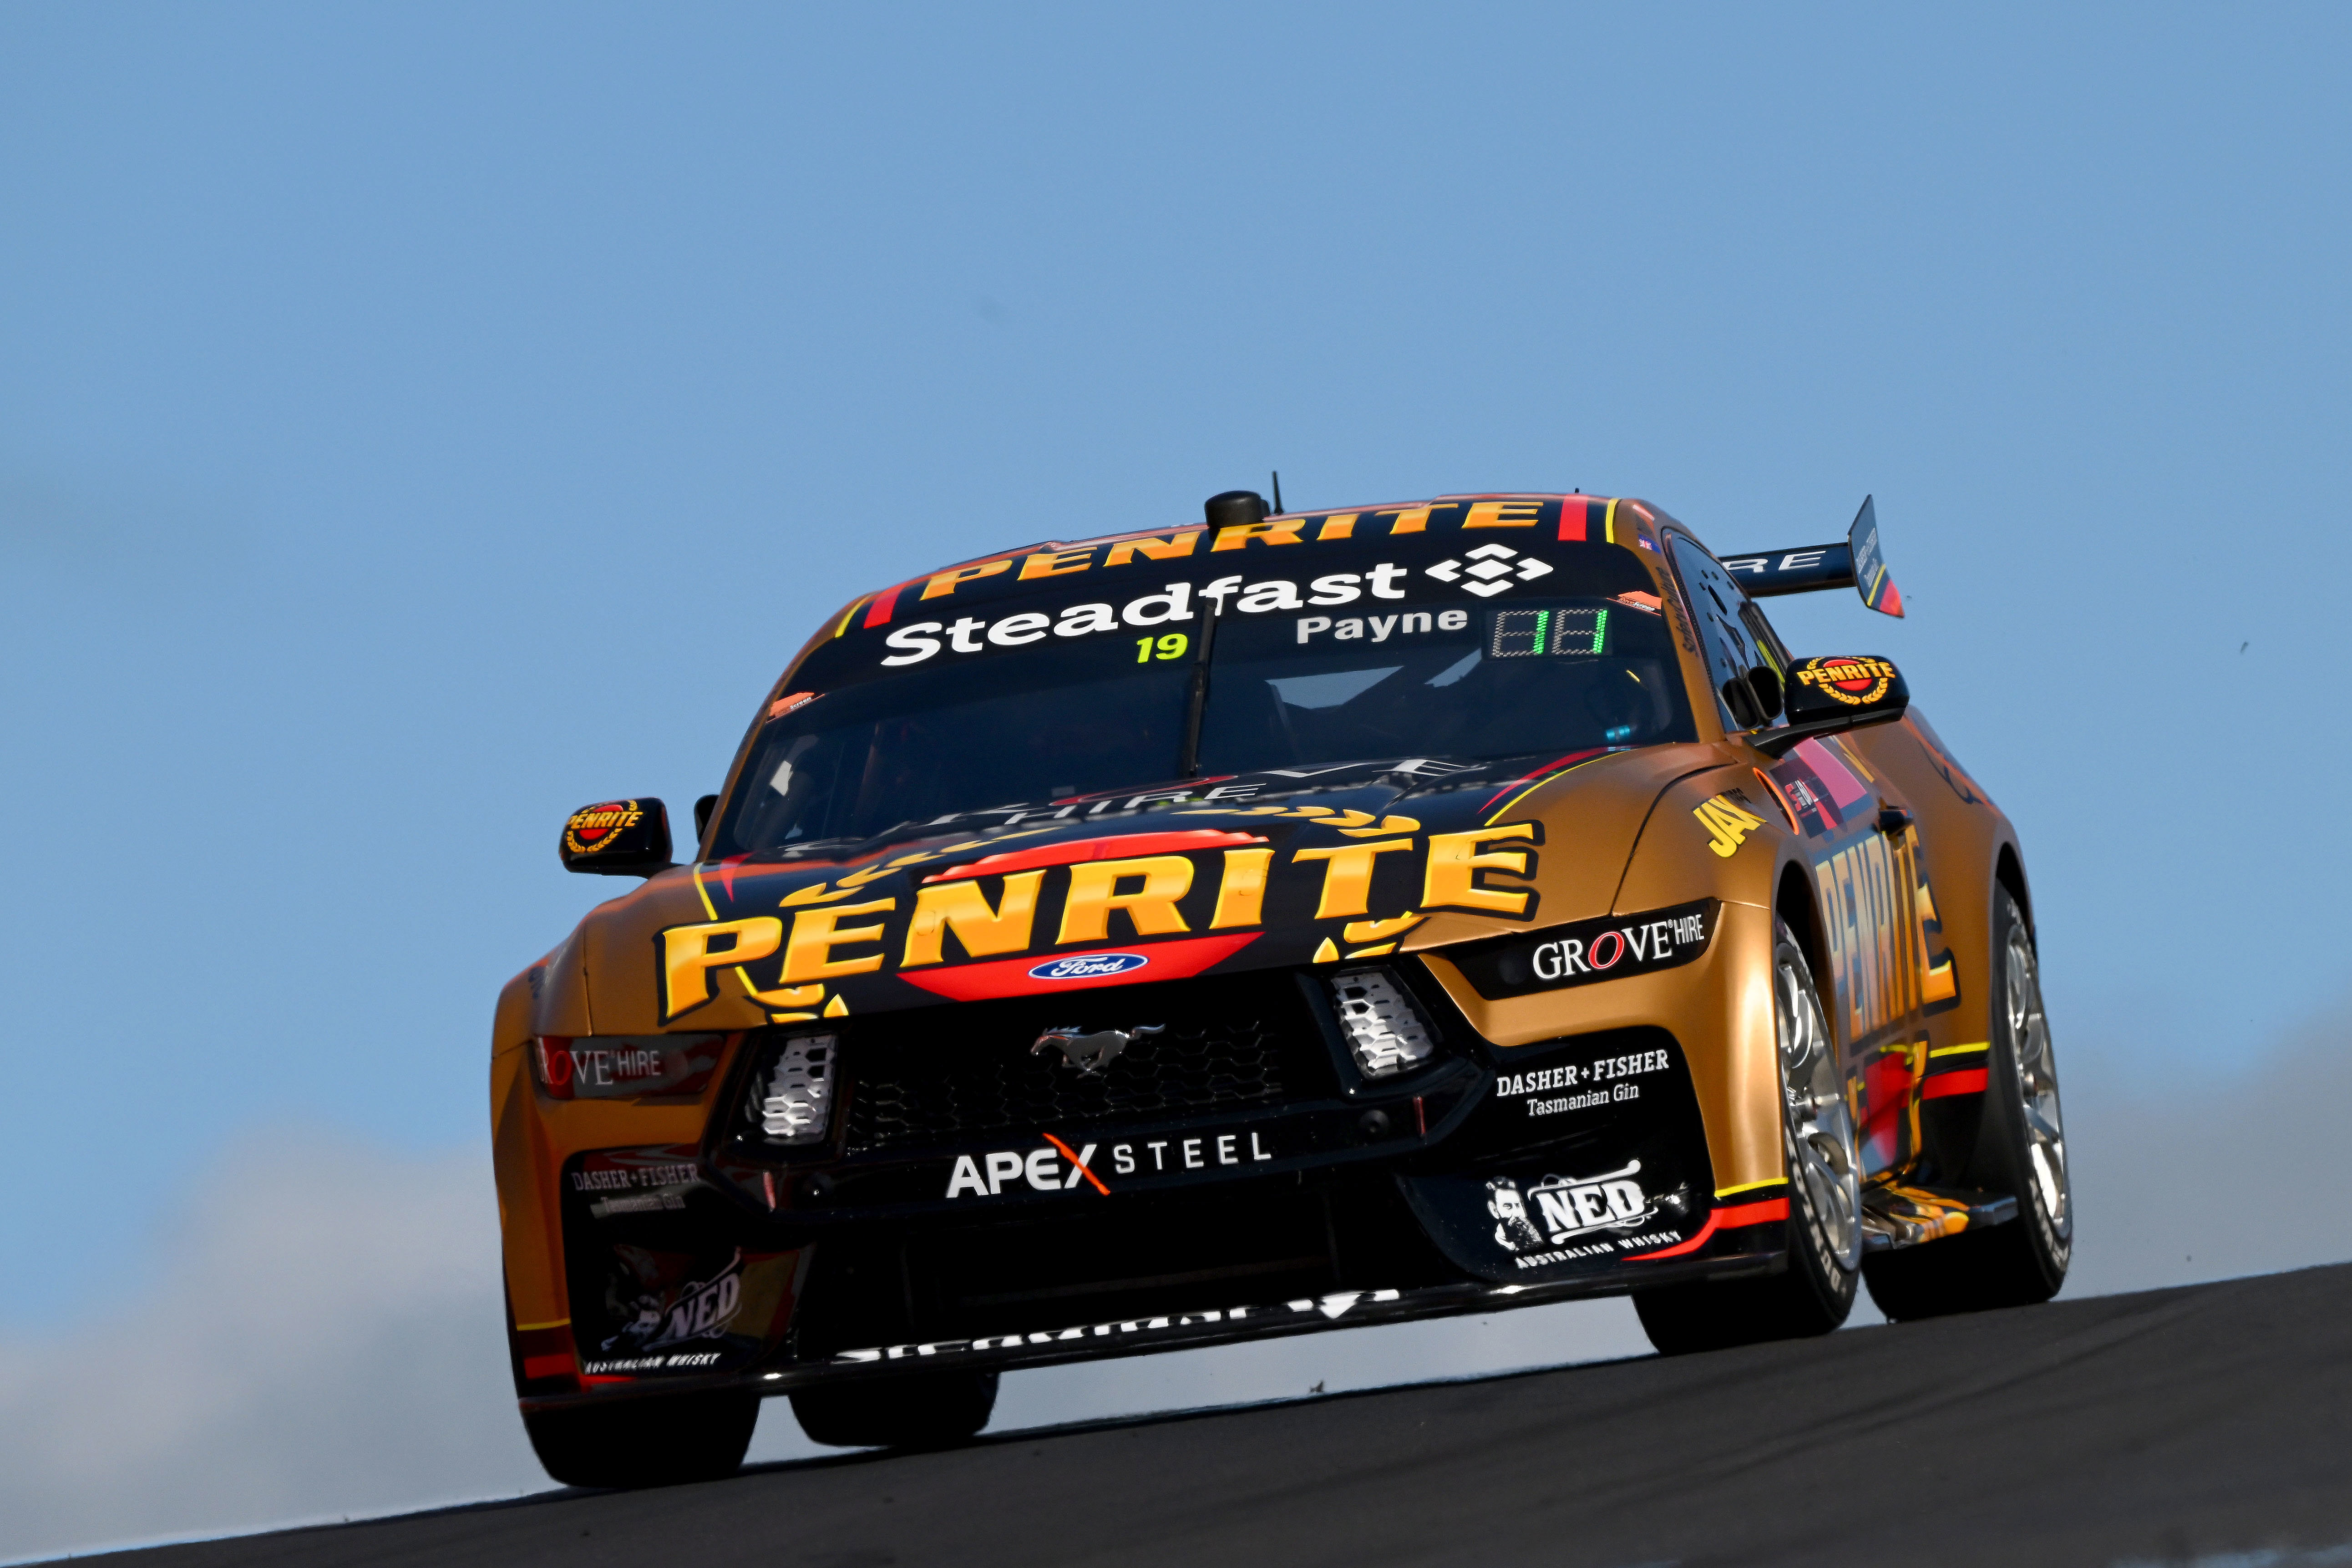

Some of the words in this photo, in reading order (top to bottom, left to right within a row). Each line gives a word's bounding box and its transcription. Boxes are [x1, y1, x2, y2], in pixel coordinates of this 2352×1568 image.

[920, 502, 1544, 601] PENRITE
[881, 563, 1408, 666] Steadfast
[1297, 609, 1468, 645] Payne
[1136, 633, 1188, 664] 19
[1796, 661, 1896, 686] PENRITE
[567, 811, 644, 829] PENRITE
[1692, 794, 1767, 858] JAX
[663, 823, 1534, 1019] PENRITE
[1050, 956, 1126, 977] Ford
[1533, 920, 1672, 980] GROVE
[1674, 913, 1705, 946] HIRE
[617, 1050, 661, 1076] HIRE
[1497, 1063, 1578, 1098] DASHER
[1593, 1049, 1669, 1081] FISHER
[1527, 1087, 1610, 1117] Tasmanian
[1613, 1083, 1640, 1102] Gin
[946, 1133, 1111, 1198] APEX
[1114, 1132, 1272, 1174] STEEL
[1536, 1180, 1647, 1233] NED
[1516, 1242, 1615, 1269] AUSTRALIAN
[1618, 1230, 1683, 1250] WHISKY
[669, 1272, 741, 1340] NED
